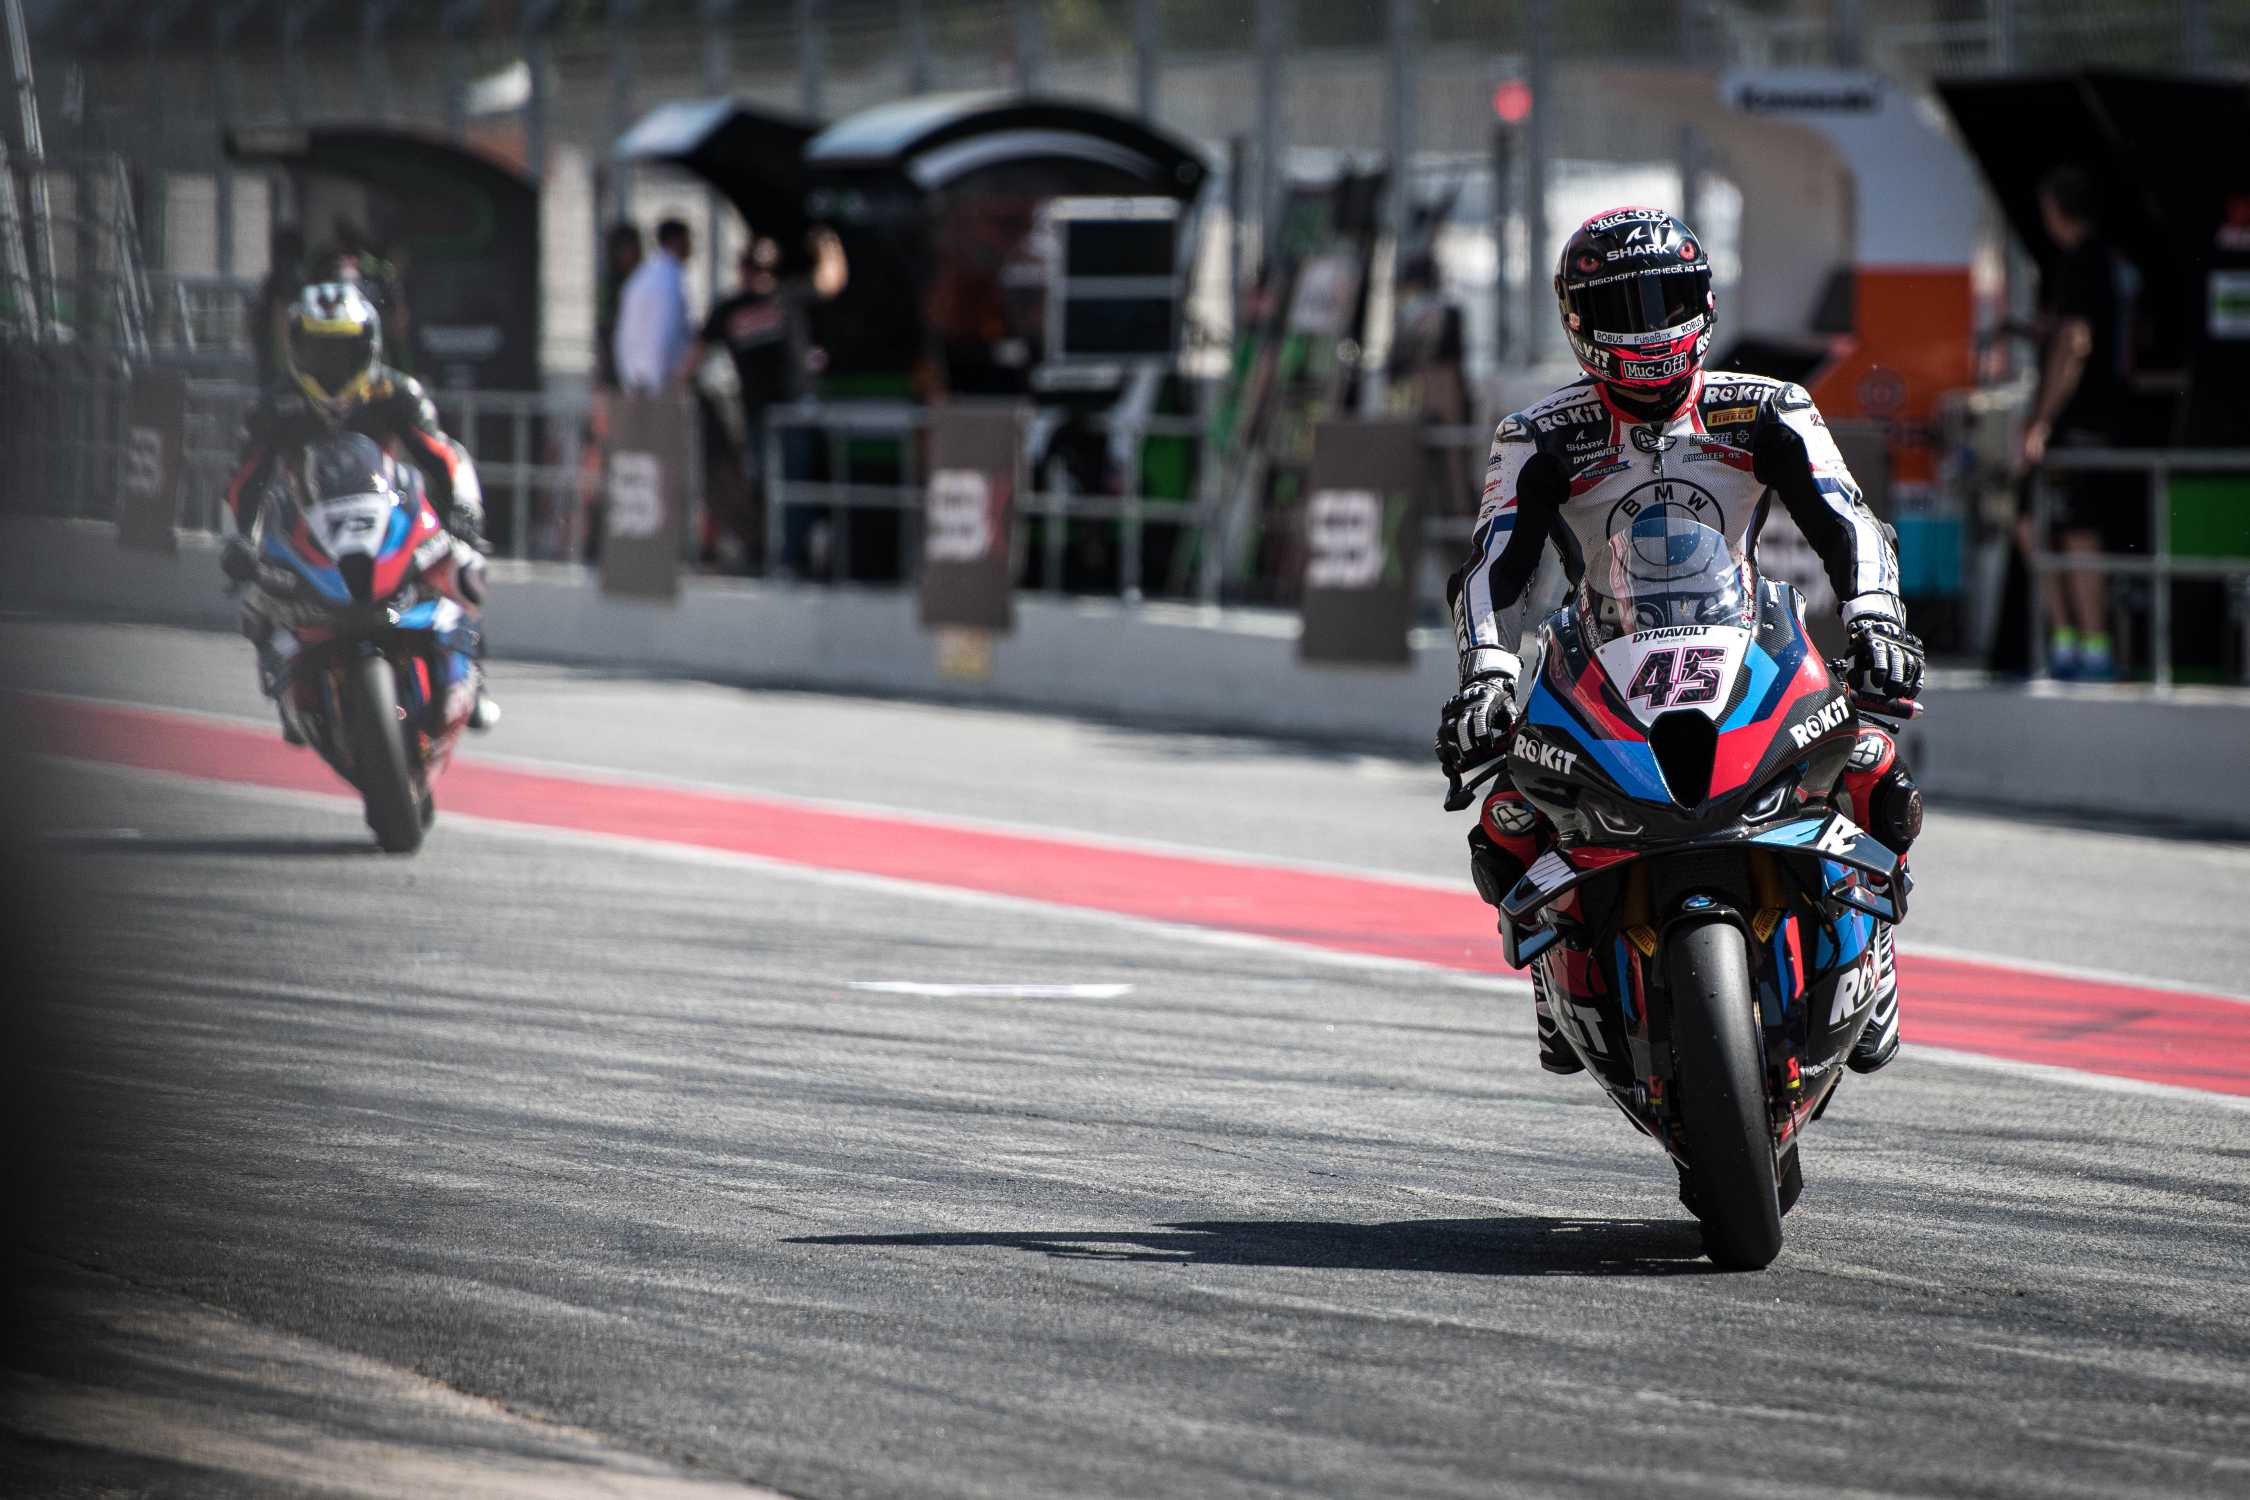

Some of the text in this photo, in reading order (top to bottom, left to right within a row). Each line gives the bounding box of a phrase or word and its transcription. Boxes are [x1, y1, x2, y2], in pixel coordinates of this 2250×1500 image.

[1606, 243, 1670, 262] SHARK
[1589, 271, 1637, 287] BISCHOFF
[1681, 317, 1703, 334] ROBUS
[1596, 332, 1624, 344] ROBUS
[1626, 354, 1686, 378] Muc-Off
[1566, 438, 1604, 452] SHARK
[1573, 444, 1625, 464] DYNAVOLT
[1621, 484, 1708, 518] BMW
[1632, 626, 1711, 644] DYNAVOLT
[1625, 645, 1729, 710] 45
[1788, 695, 1850, 749] ROKiT
[1513, 734, 1578, 775] ROKiT
